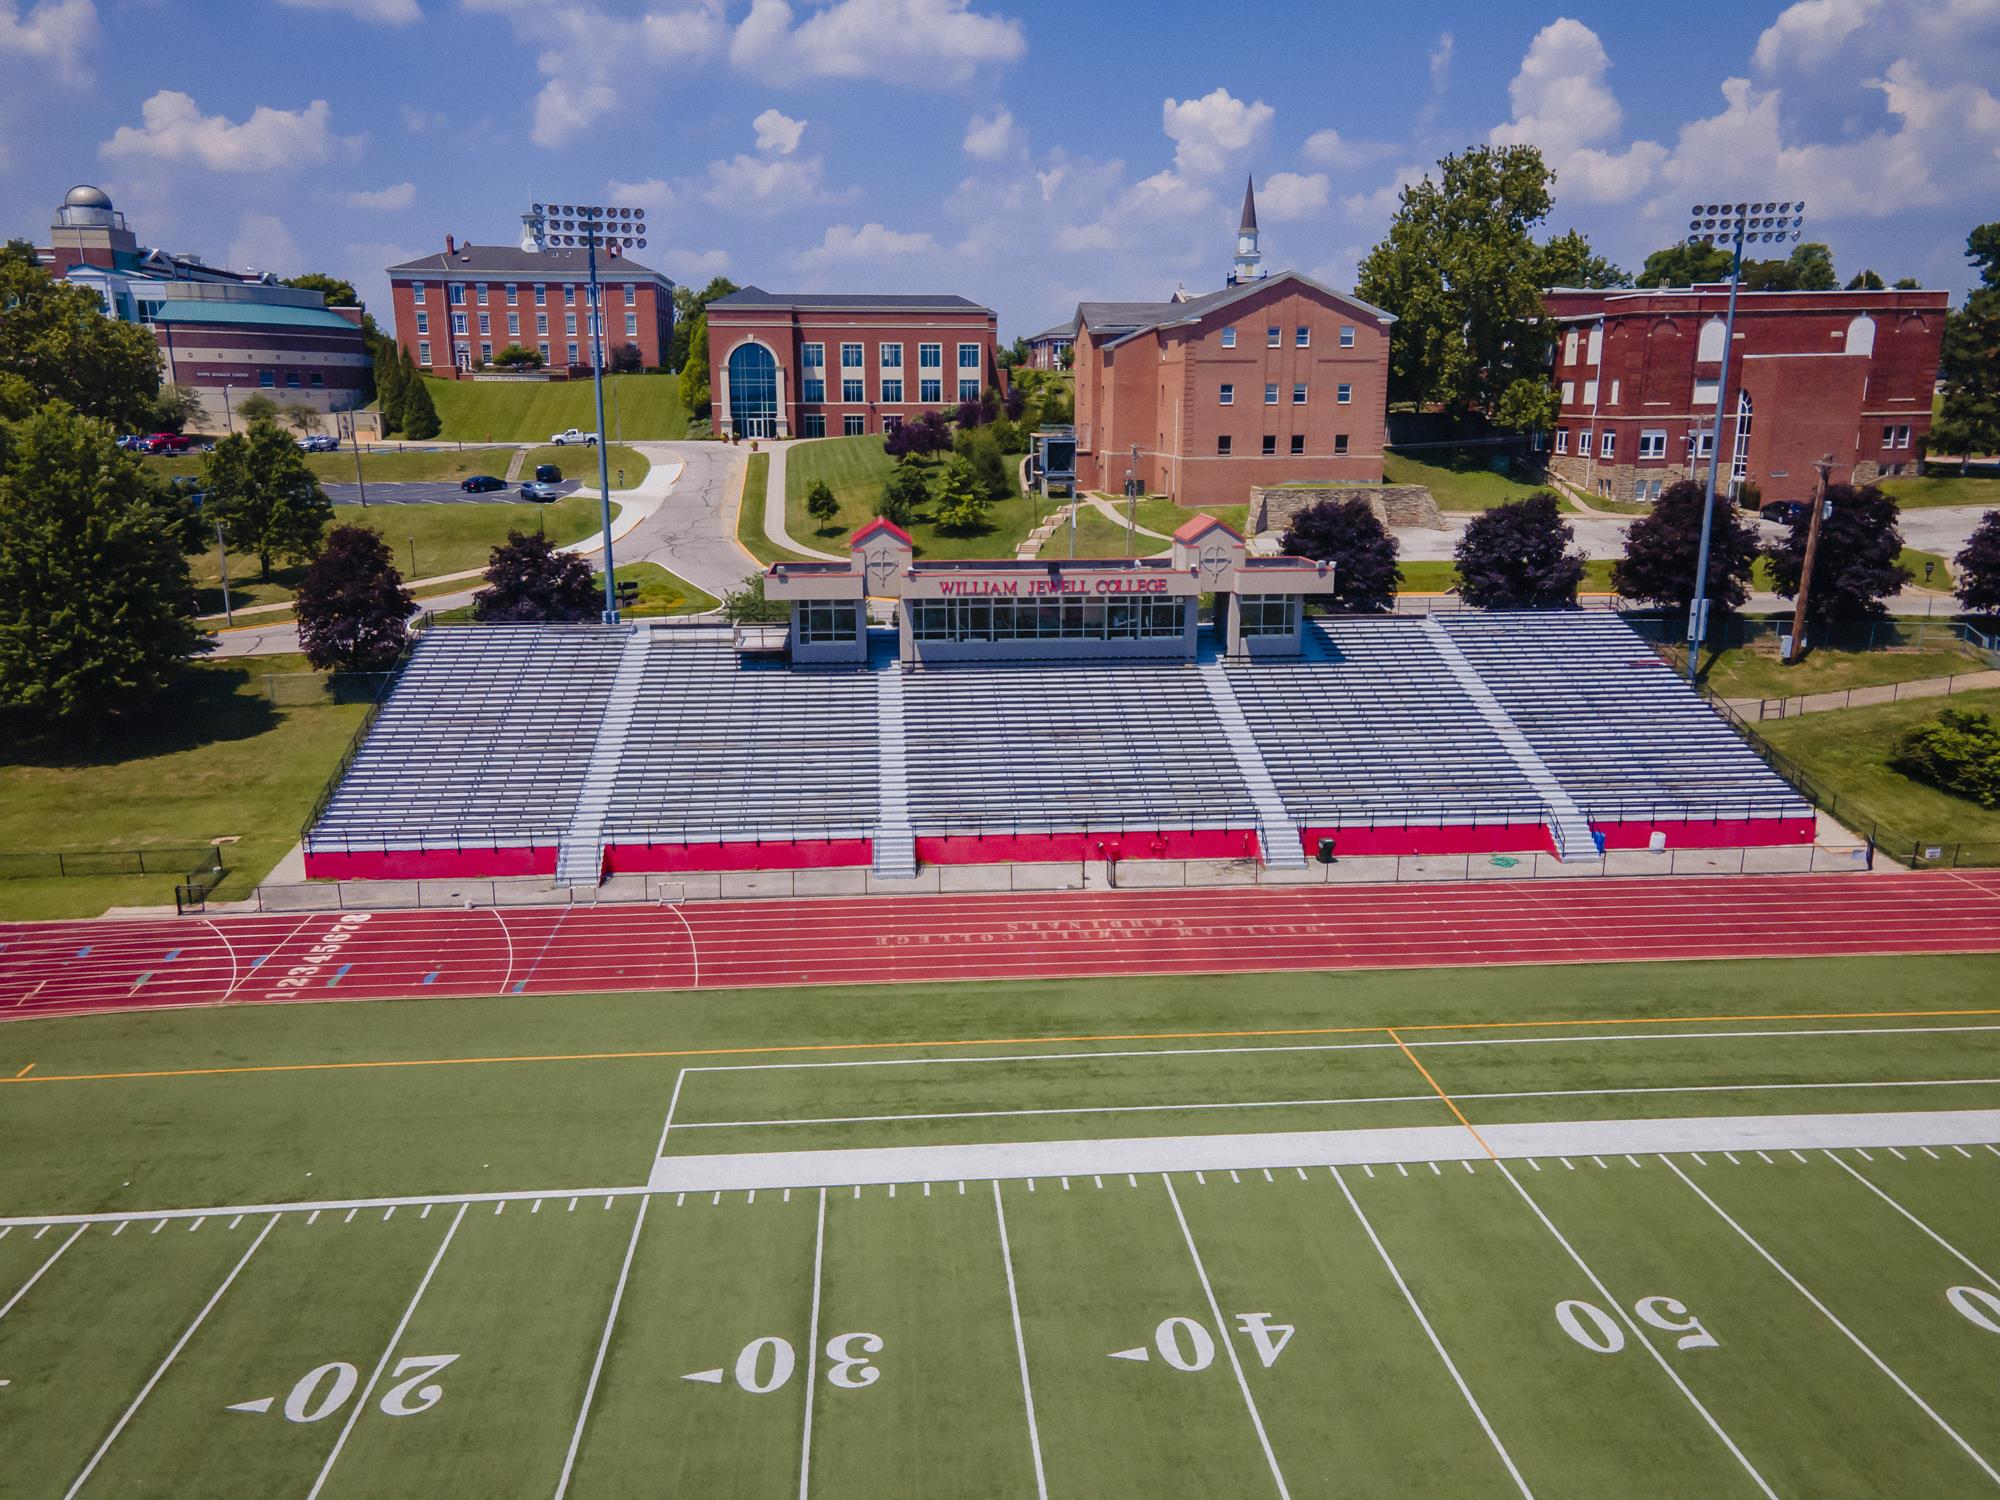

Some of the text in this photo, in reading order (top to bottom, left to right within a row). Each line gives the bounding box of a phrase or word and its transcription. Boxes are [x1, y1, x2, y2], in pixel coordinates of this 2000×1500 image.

[939, 578, 1168, 596] WILLIAM JEWELL COLLEGE
[1006, 919, 1184, 932] CARDINALS
[875, 925, 1322, 946] WILLIAM JEWELL COLLEGE
